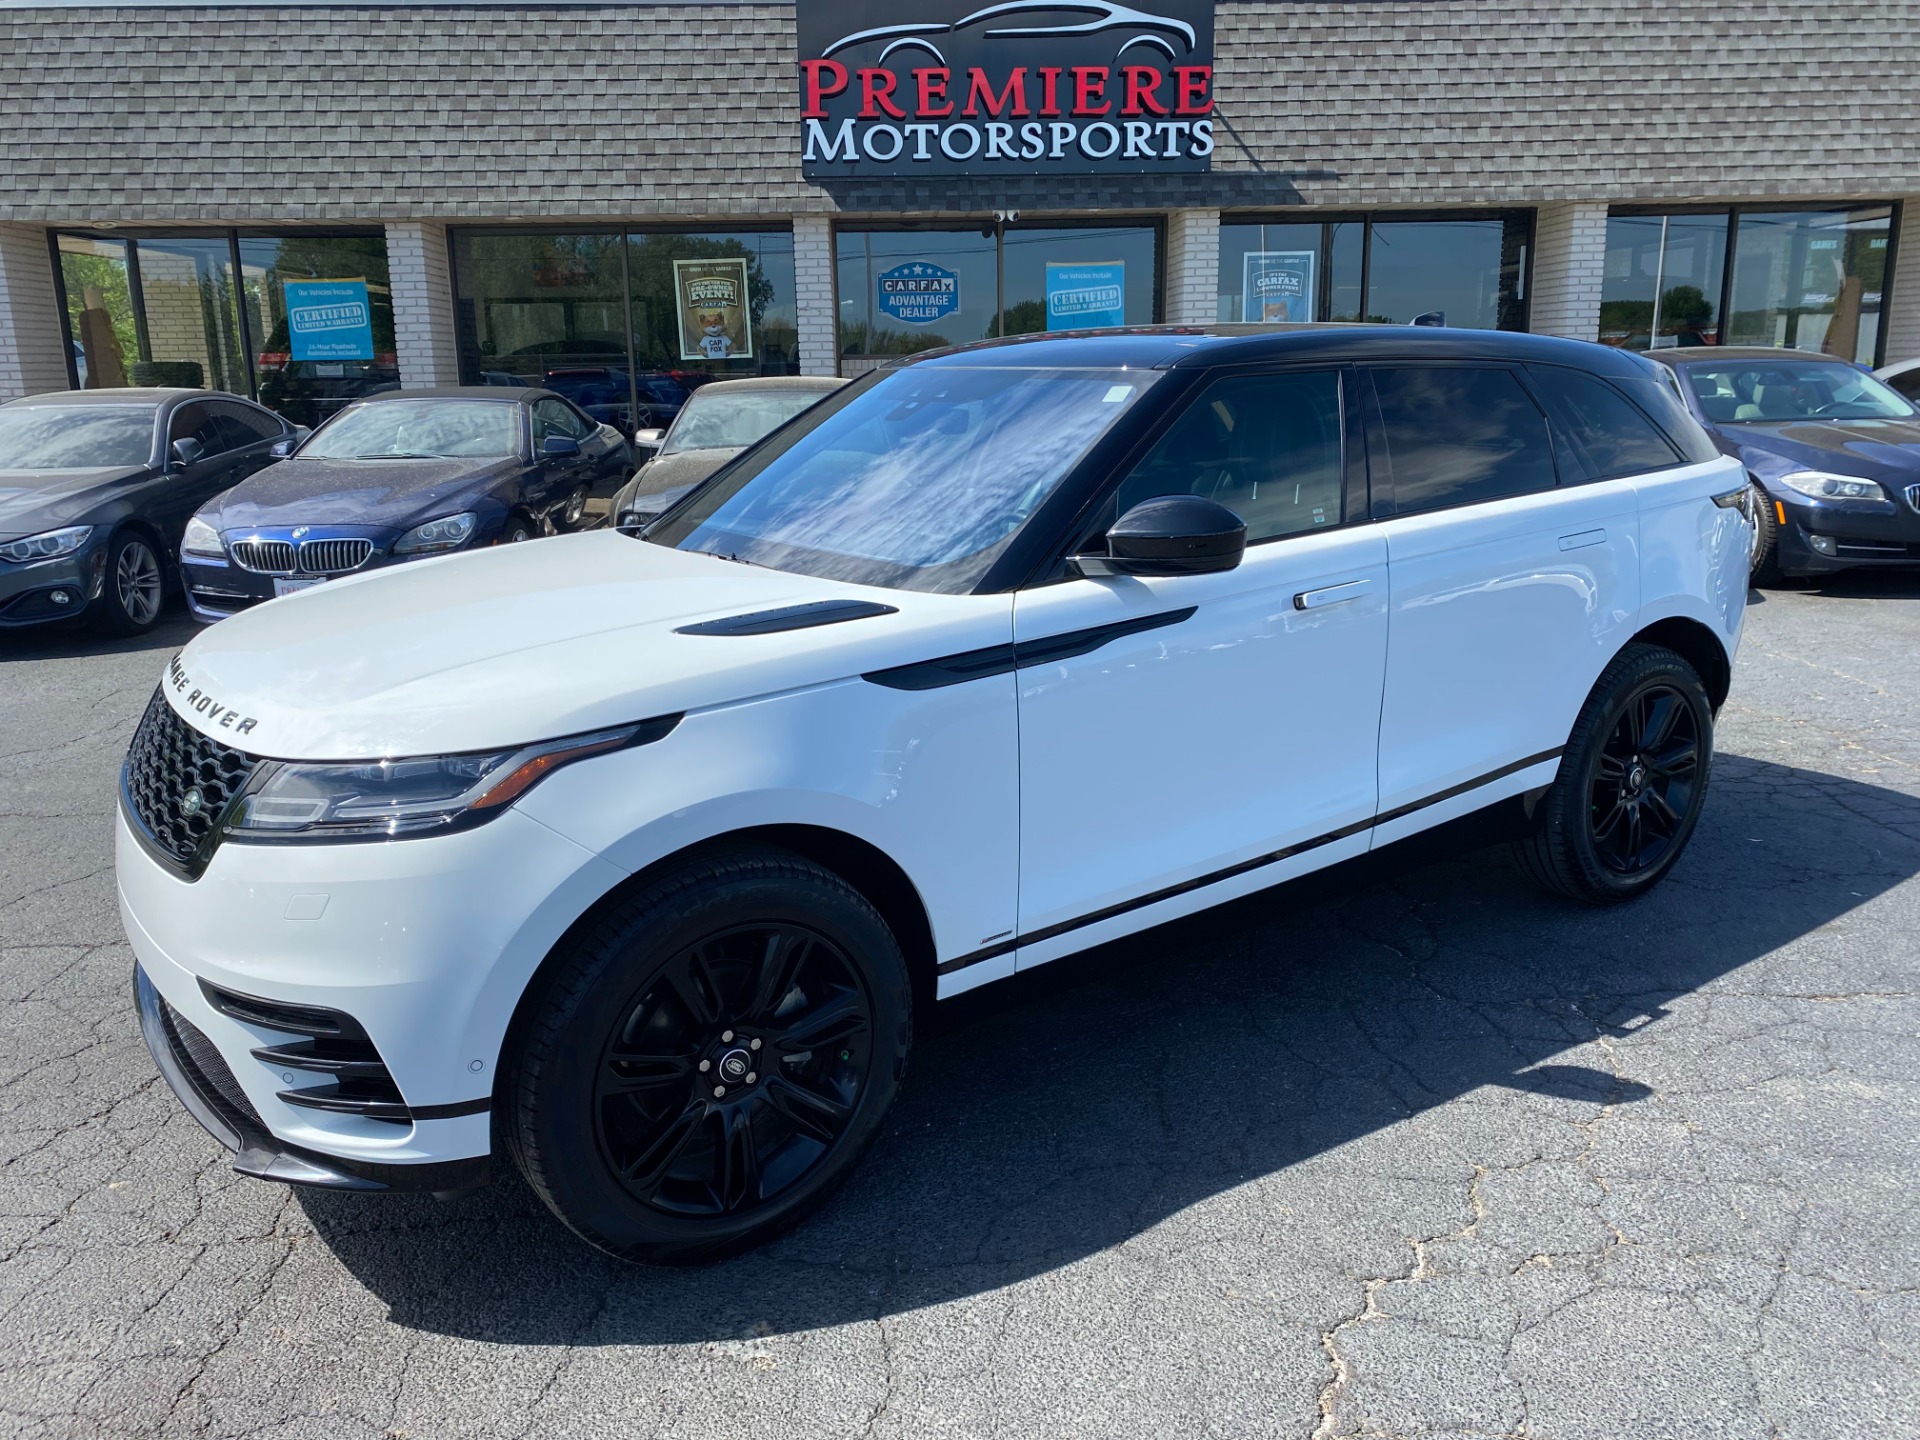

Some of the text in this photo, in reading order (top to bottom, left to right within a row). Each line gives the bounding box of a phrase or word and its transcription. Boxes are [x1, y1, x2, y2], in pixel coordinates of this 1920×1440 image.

[801, 59, 1214, 117] PREMIERE
[803, 118, 1214, 161] MOTORSPORTS
[1811, 240, 1837, 249] GAMES
[884, 280, 952, 292] CARFAX
[1257, 277, 1299, 286] CARFAX
[692, 290, 734, 300] EVENT!
[889, 295, 949, 306] ADVANTAGE
[1054, 289, 1117, 305] CERTIFIED
[1082, 300, 1117, 309] WARRANTY
[296, 306, 361, 322] CERTIFIED
[900, 307, 938, 318] DEALER
[297, 317, 362, 329] LIMITED WARRANTY
[187, 688, 258, 735] ROVER
